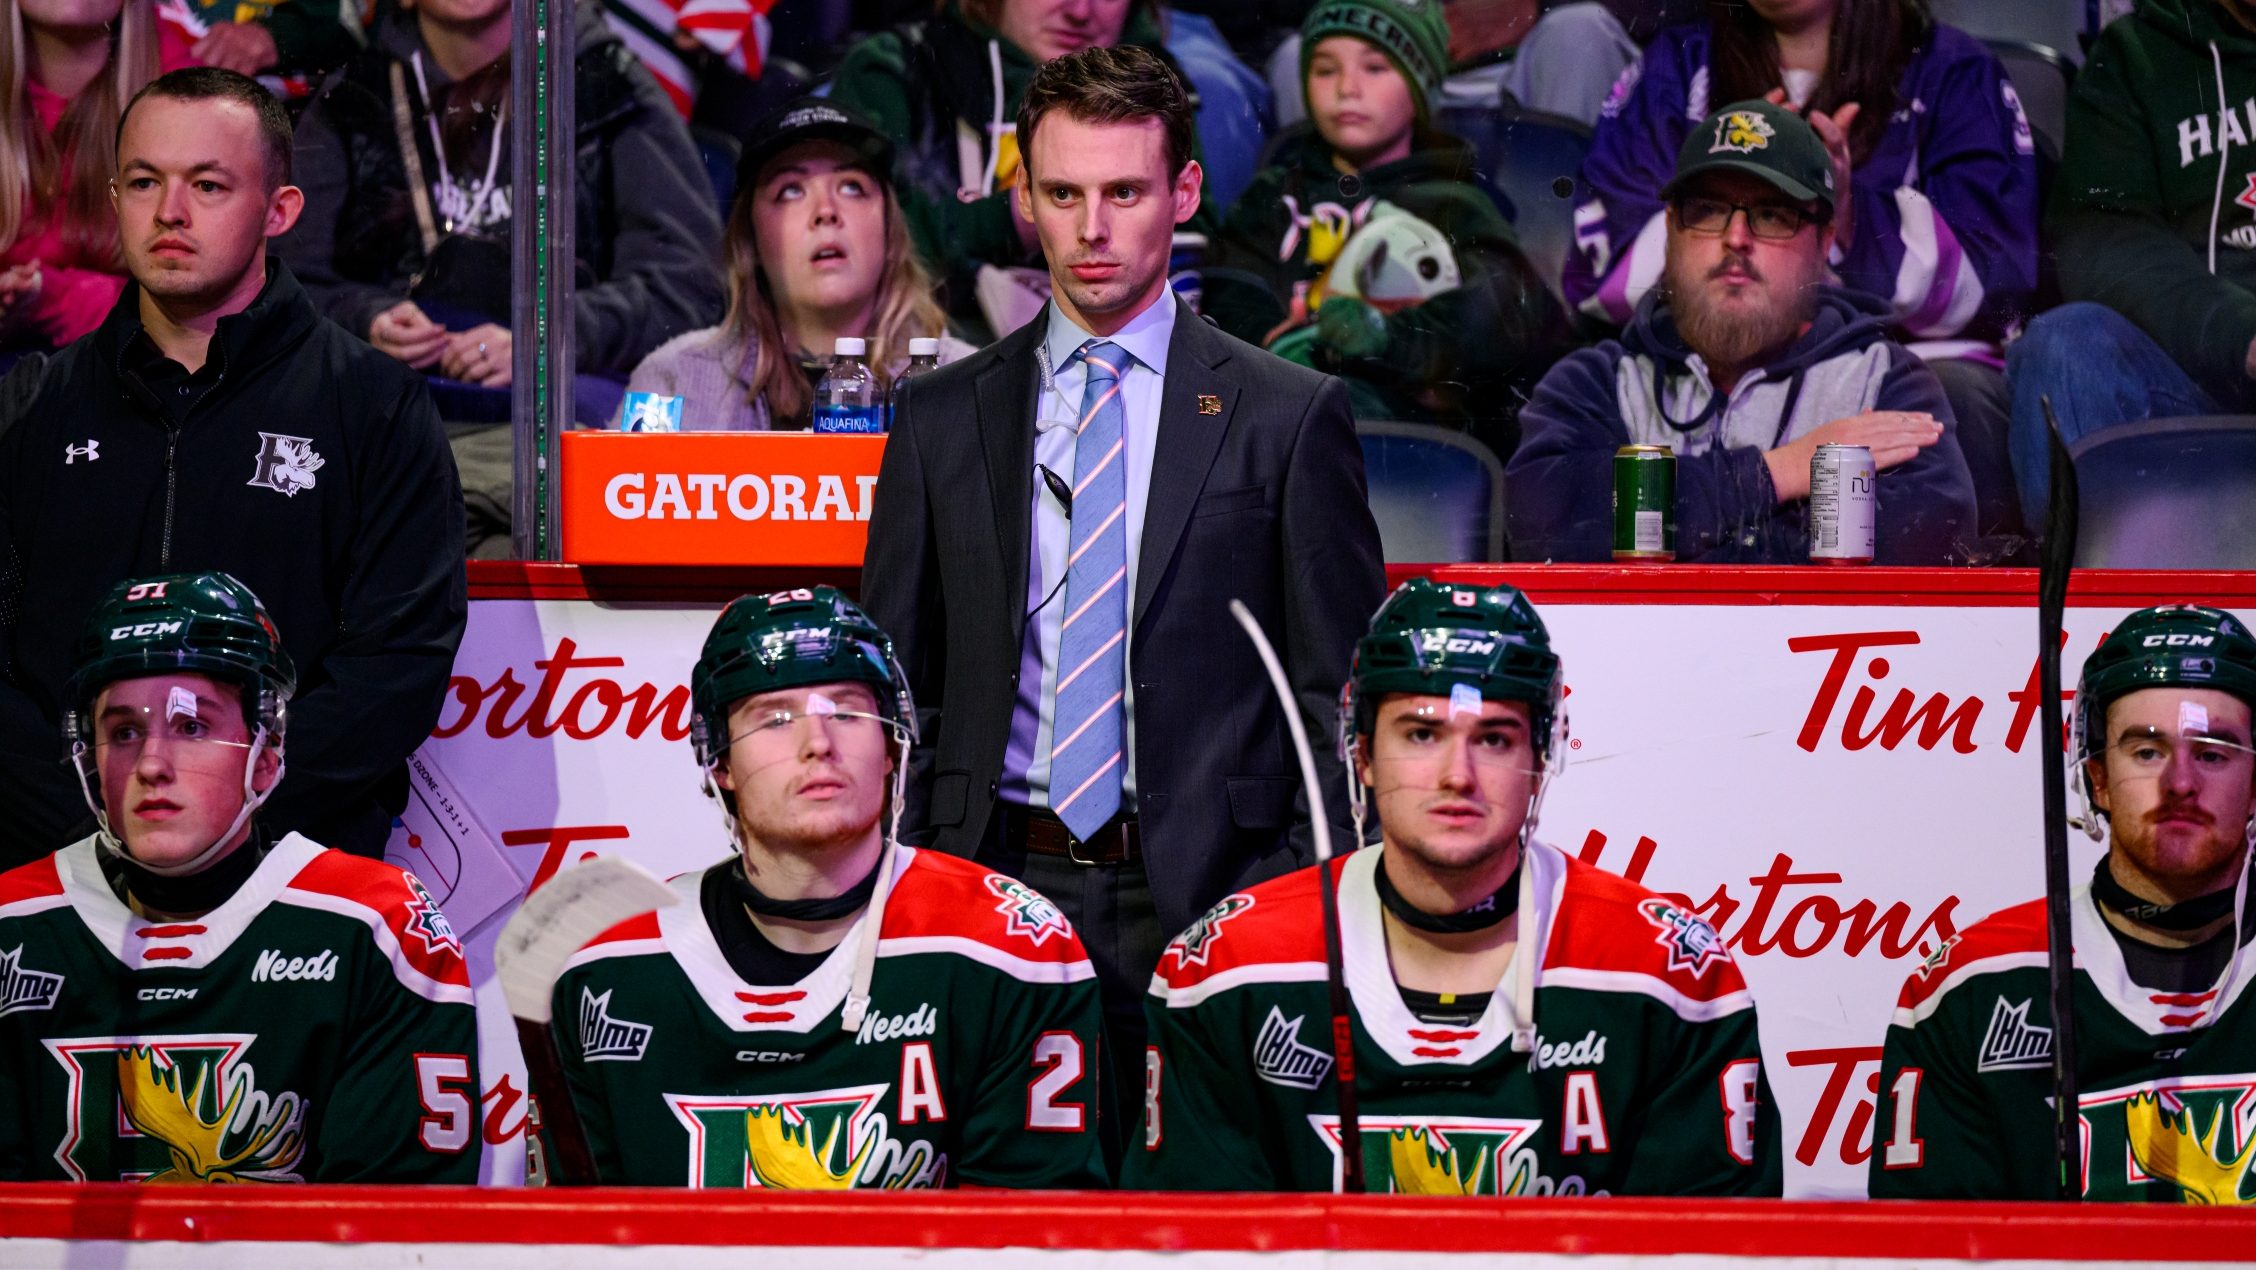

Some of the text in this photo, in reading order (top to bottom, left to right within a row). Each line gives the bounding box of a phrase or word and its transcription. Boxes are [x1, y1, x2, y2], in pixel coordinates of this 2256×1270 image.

[818, 416, 870, 433] AQUAFINA
[110, 621, 183, 640] CCM
[1423, 637, 1496, 655] CCM
[2143, 634, 2215, 647] CCM
[430, 637, 691, 742] orton
[1787, 630, 1985, 754] Tim
[1577, 828, 1961, 960] rtons
[136, 988, 199, 1001] CCM
[251, 949, 340, 982] Needs
[735, 1050, 806, 1063] CCM
[856, 1002, 938, 1045] Needs
[413, 1053, 473, 1154] 5
[898, 1041, 947, 1125] A
[1025, 1030, 1085, 1132] 2
[1560, 1070, 1611, 1156] A
[1786, 1046, 1884, 1166] Ti
[1883, 1066, 1925, 1170] 1
